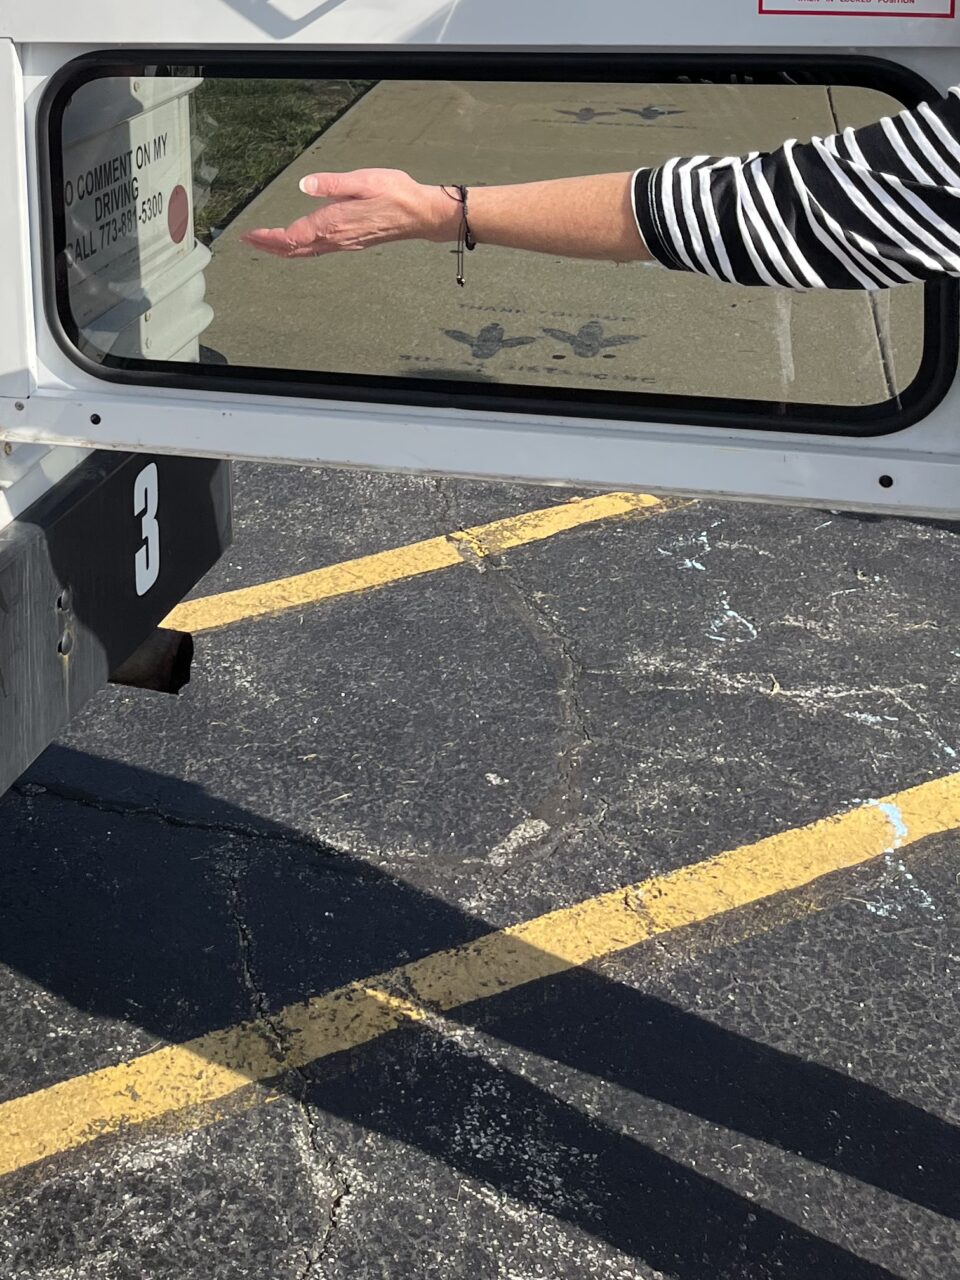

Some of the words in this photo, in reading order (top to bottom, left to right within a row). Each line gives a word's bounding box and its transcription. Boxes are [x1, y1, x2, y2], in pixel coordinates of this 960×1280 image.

[64, 180, 74, 207] O
[77, 150, 133, 201] COMMENT
[135, 141, 151, 170] ON
[153, 132, 168, 162] MY
[94, 176, 139, 222] DRIVING
[99, 191, 163, 250] 773-881-5300
[133, 462, 160, 597] 3
